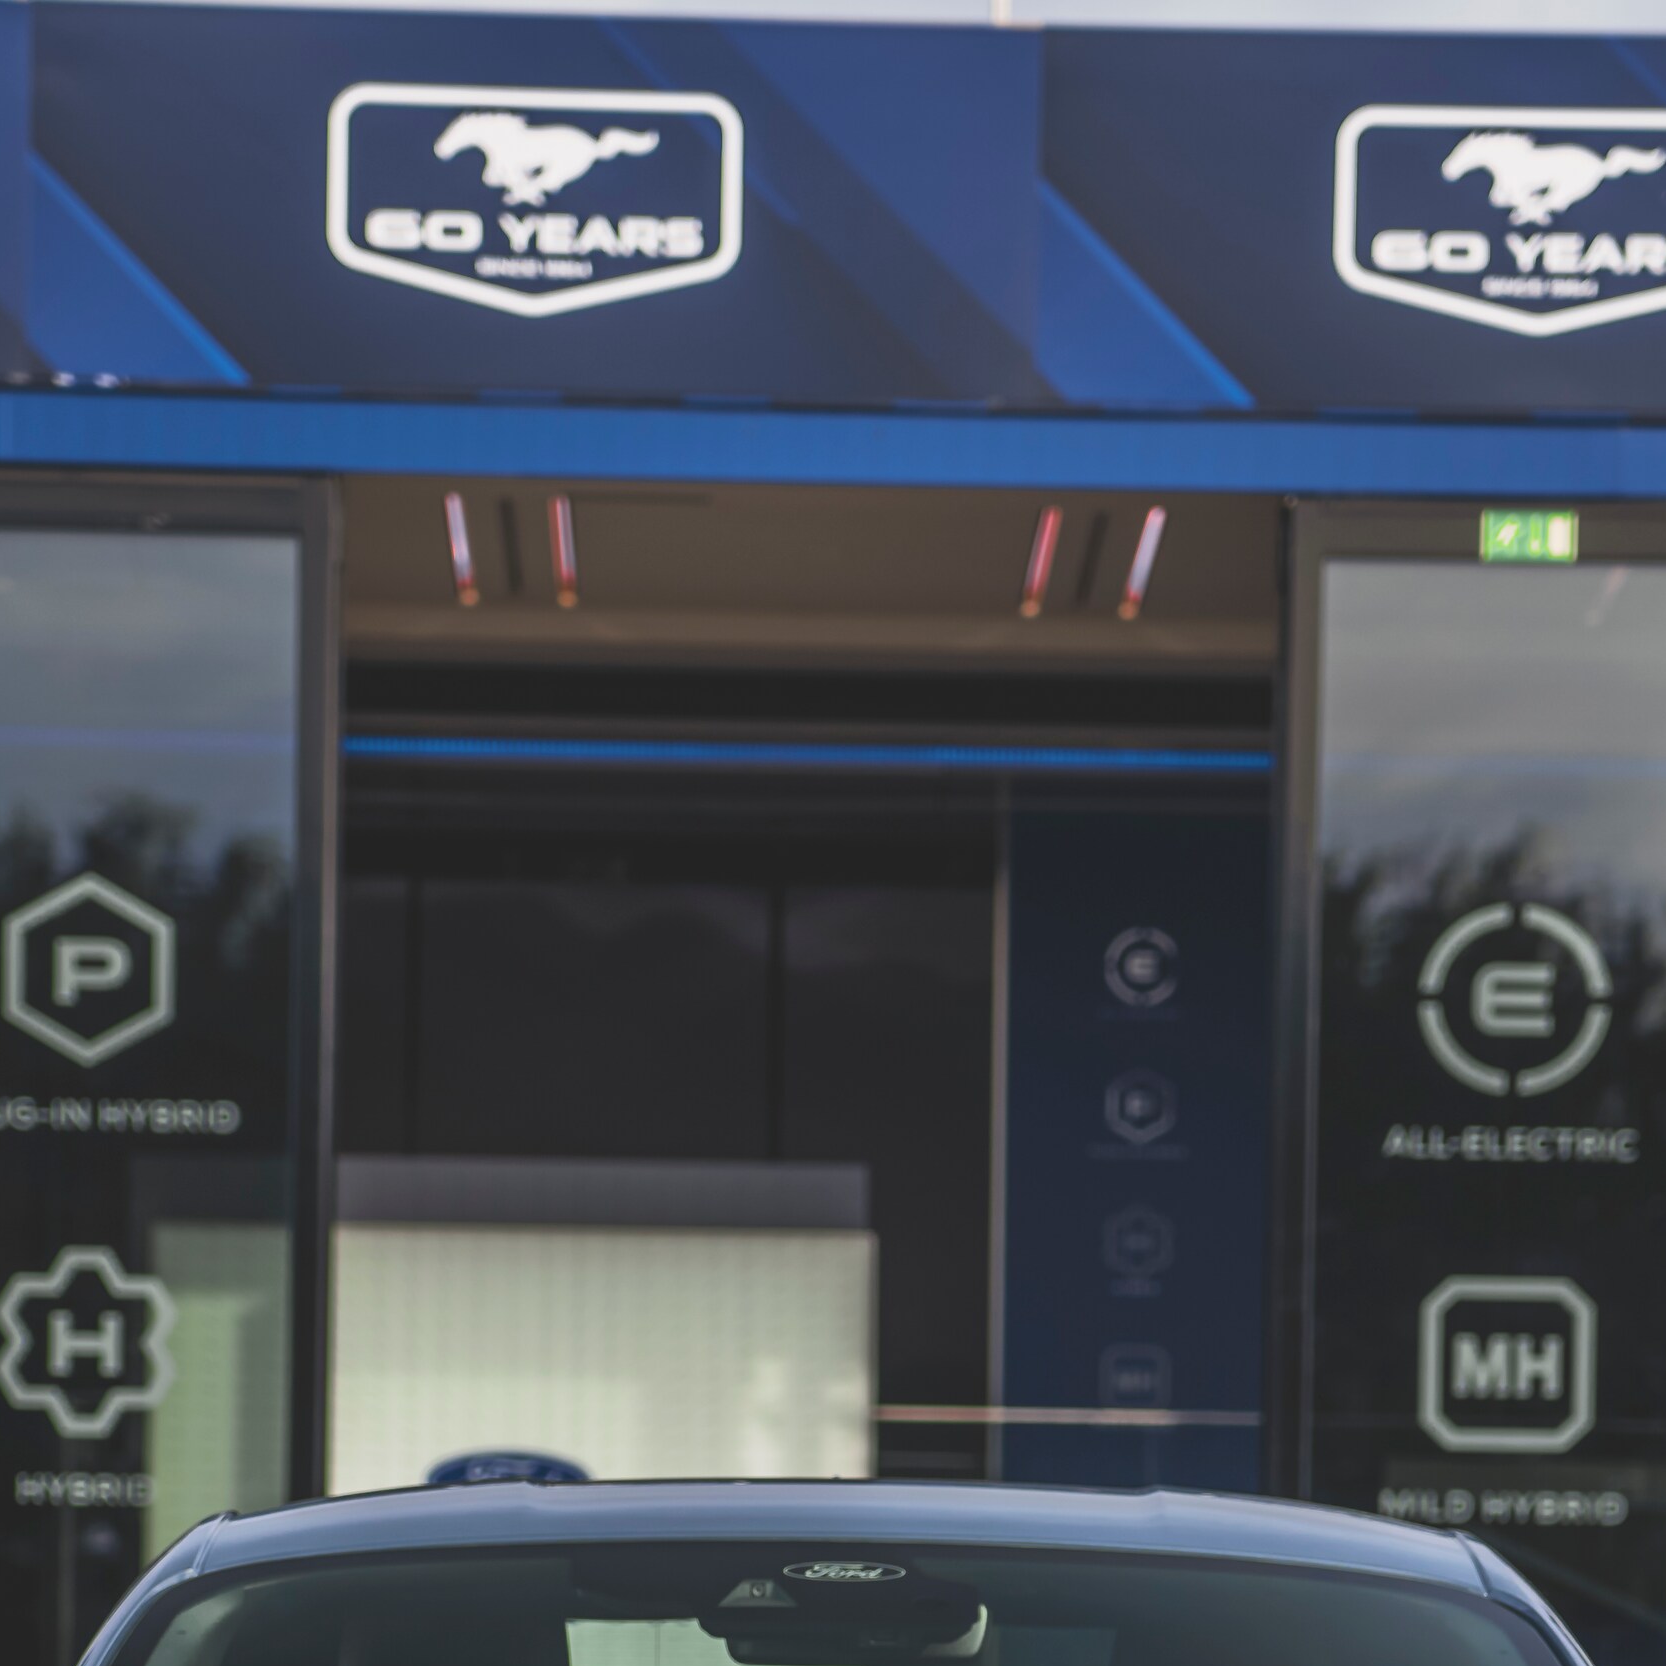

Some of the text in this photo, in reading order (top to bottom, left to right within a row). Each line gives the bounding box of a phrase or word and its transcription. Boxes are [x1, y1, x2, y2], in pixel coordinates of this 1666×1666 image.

[365, 209, 705, 258] 60 YEARS
[1371, 230, 1491, 273] 60
[53, 936, 132, 1006] P
[1471, 962, 1556, 1037] E
[97, 1098, 241, 1134] HYBRID
[1383, 1125, 1640, 1163] ALL-ELECTRIC
[48, 1310, 123, 1378] H
[1452, 1332, 1564, 1400] MH
[15, 1471, 154, 1506] HYBRID
[1378, 1487, 1629, 1526] MILD HYBRID
[805, 1564, 884, 1579] Ford
